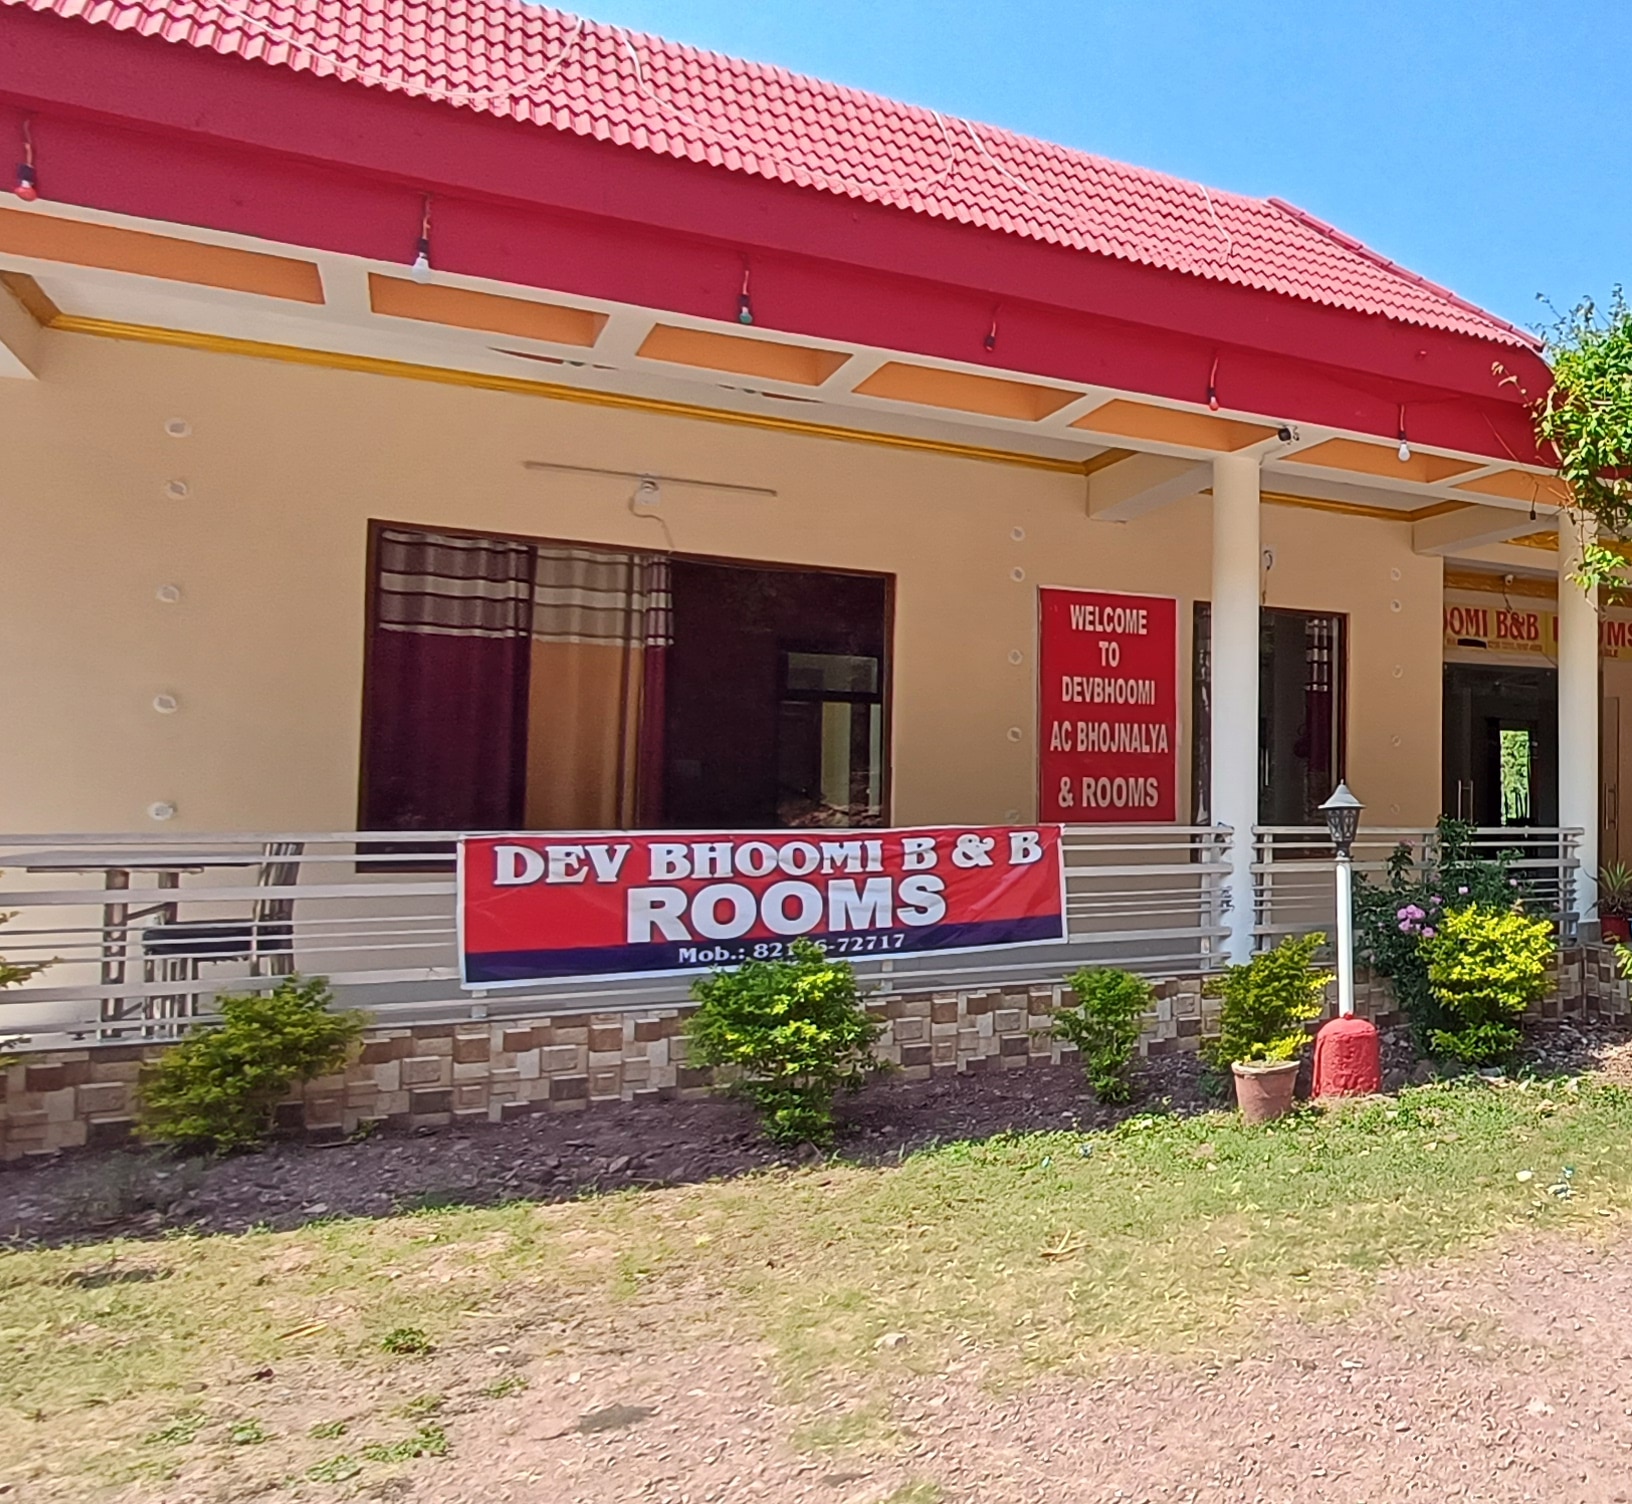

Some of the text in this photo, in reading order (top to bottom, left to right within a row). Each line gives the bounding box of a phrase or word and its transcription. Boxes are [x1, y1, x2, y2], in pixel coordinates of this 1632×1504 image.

[1070, 604, 1148, 635] WELCOME
[1496, 611, 1539, 641] B&B
[1099, 641, 1120, 667] TO
[1061, 676, 1156, 705] DEVBHOOMI
[1050, 721, 1169, 753] AC BHOJNALYA
[1058, 776, 1159, 807] & ROOMS
[493, 830, 1043, 886] DEV BHOOMI B & B
[626, 874, 947, 944] ROOMS
[678, 934, 905, 963] Mob.: 8216-72717
